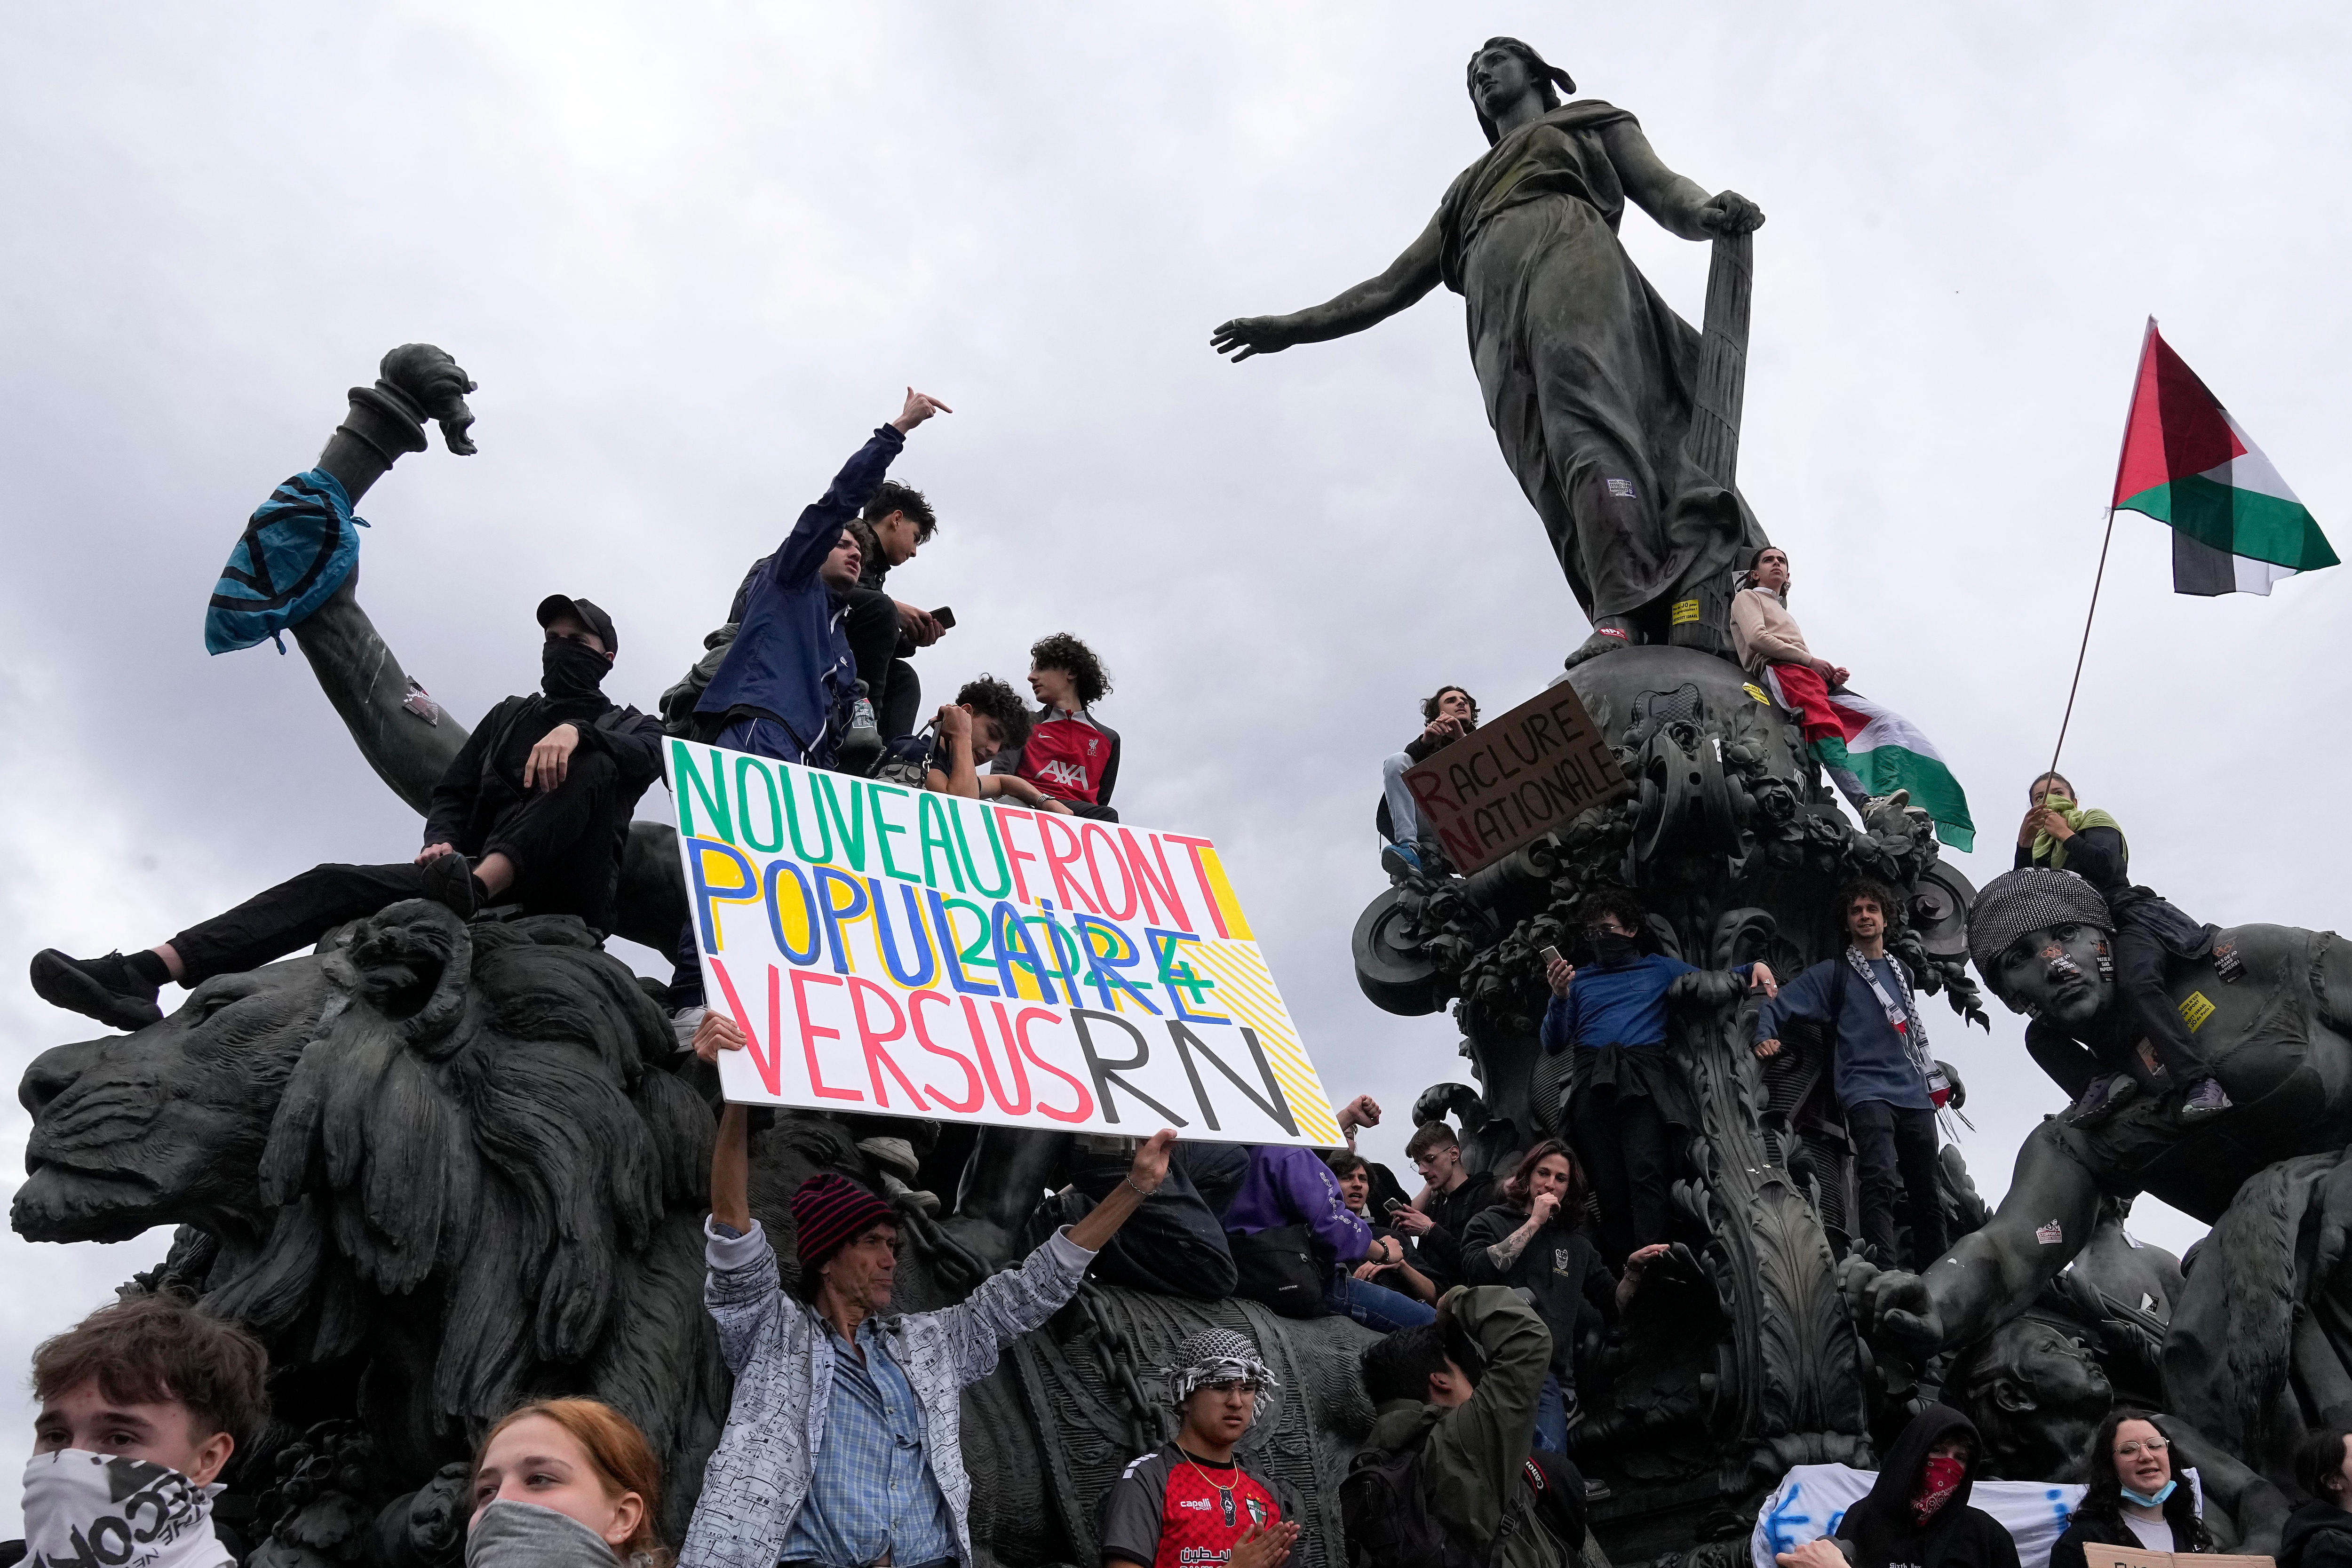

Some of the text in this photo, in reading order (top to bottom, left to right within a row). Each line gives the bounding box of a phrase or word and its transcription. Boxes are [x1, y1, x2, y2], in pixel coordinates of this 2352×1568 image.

[1406, 699, 1585, 822] RACLURE
[1035, 760, 1089, 790] AXA
[1438, 740, 1626, 870] NATIONALE
[671, 740, 1230, 939] NOUVEAU FRONT
[2214, 958, 2224, 967] PAS
[2221, 958, 2233, 968] SANS
[2179, 1003, 2190, 1014] OCIDE
[2188, 999, 2200, 1011] SPORT
[2186, 1003, 2207, 1025] COTT ISRAEL
[2201, 1007, 2209, 1016] Paris
[709, 957, 1301, 1137] VERSUS RN
[1180, 1498, 1211, 1510] capelli
[1248, 1505, 1267, 1516] PALESTINO
